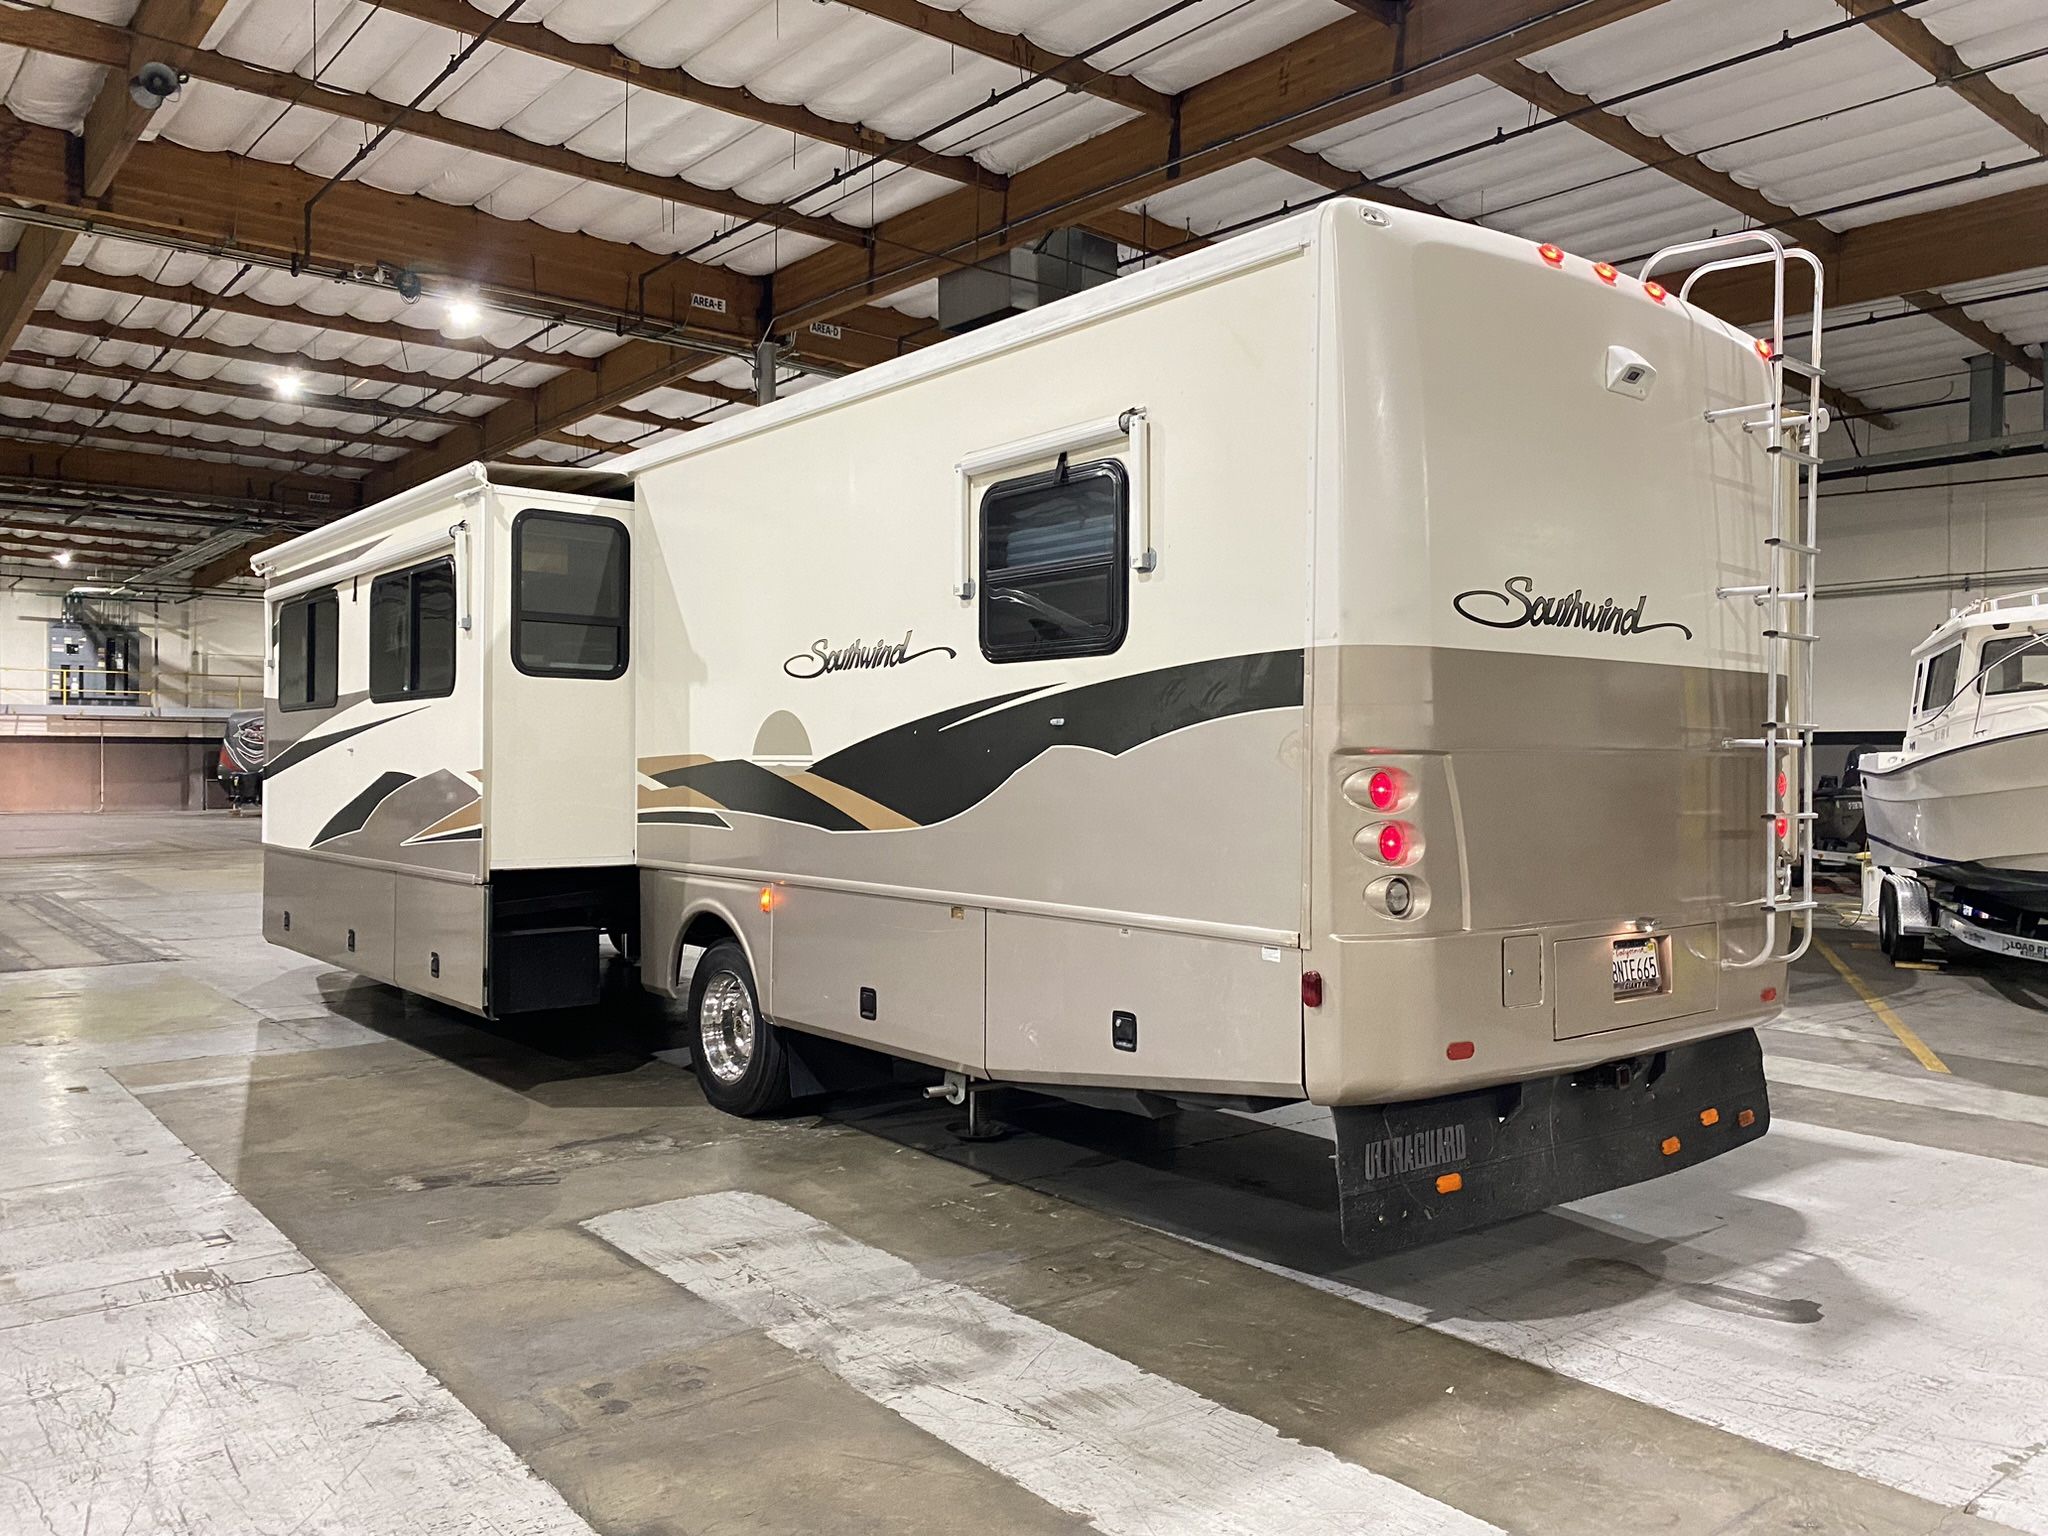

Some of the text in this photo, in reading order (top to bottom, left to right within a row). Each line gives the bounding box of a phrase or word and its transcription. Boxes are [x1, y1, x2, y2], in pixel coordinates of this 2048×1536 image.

[693, 295, 723, 310] AREA-E
[812, 323, 839, 337] AREA-D
[1453, 575, 1692, 640] Southwind
[783, 629, 957, 679] Southwind
[2011, 941, 2035, 952] LOAD
[1364, 1124, 1467, 1181] ULTRAGUARD
